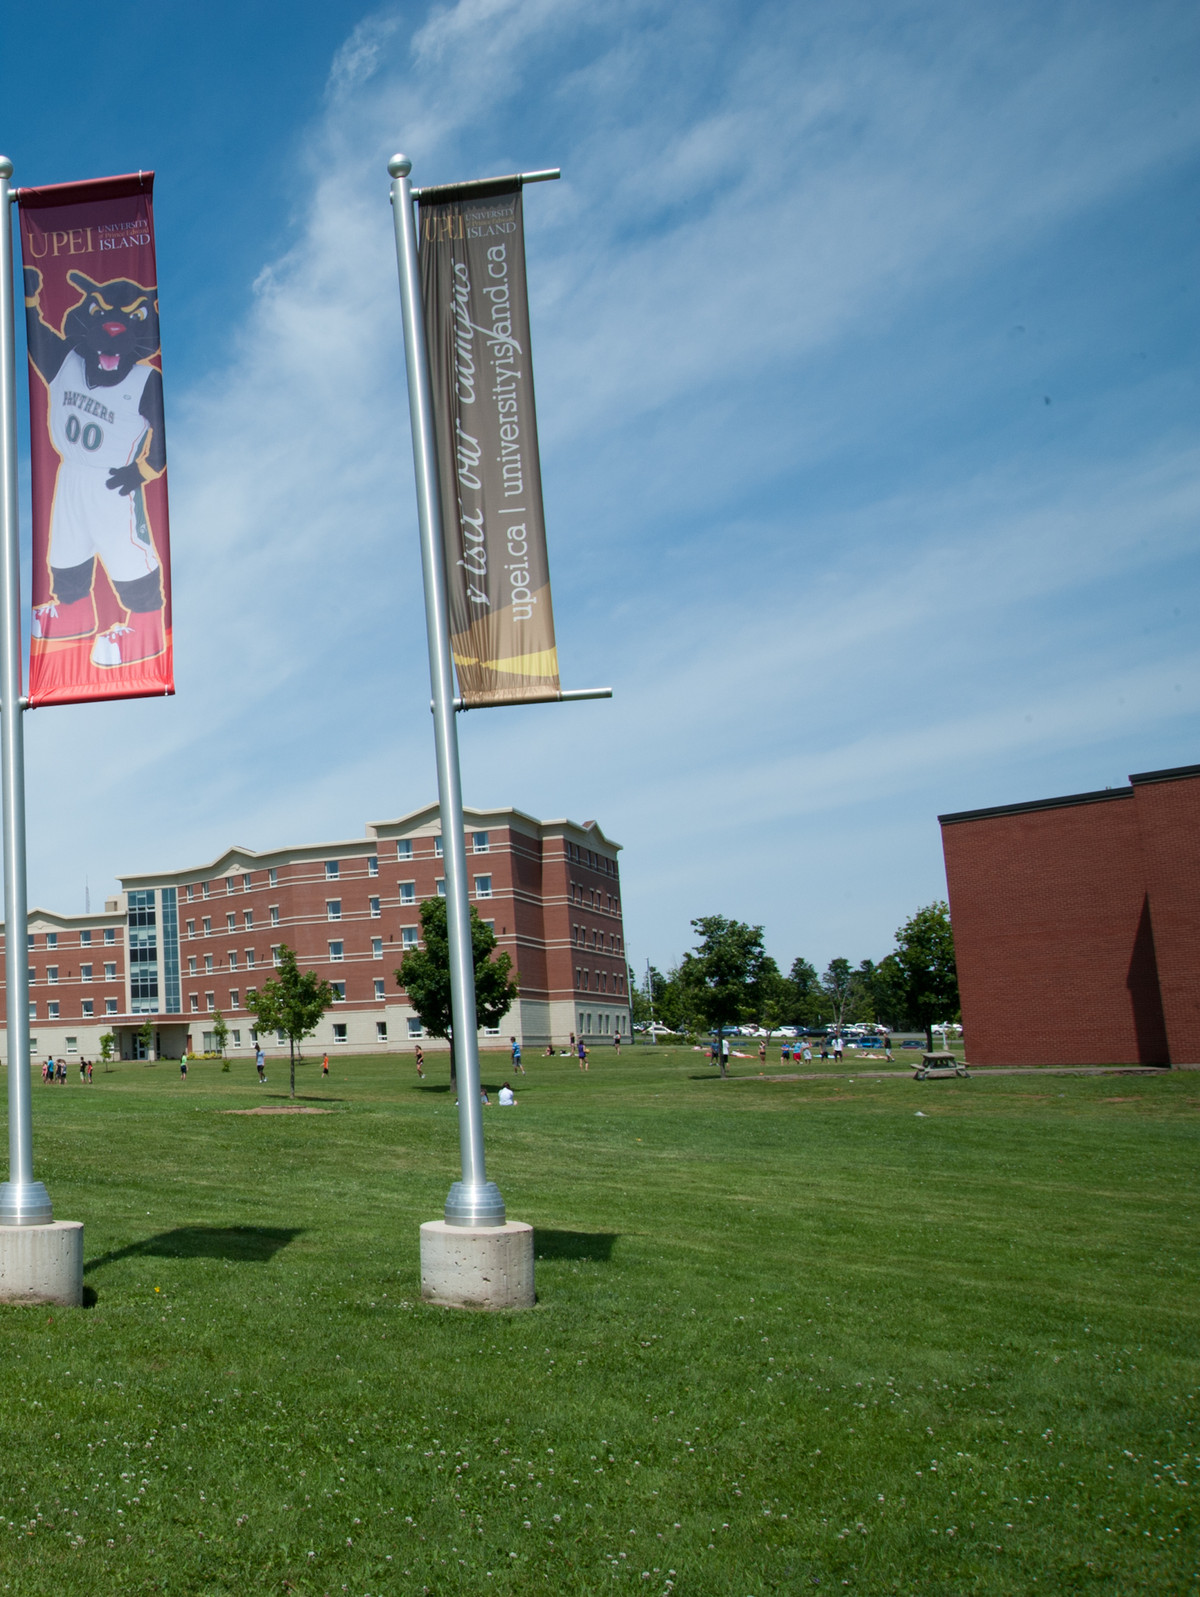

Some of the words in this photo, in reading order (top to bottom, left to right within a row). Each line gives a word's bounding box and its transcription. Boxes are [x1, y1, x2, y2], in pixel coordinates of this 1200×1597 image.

[465, 207, 515, 221] UNIVERSITY
[97, 220, 148, 233] UNIVERSITY
[467, 222, 517, 239] ISLAND
[27, 227, 95, 258] UPEI
[100, 233, 151, 251] ISLAND
[483, 243, 524, 497] universityisland.ca
[65, 413, 104, 452] 00
[504, 523, 537, 622] upei.ca
